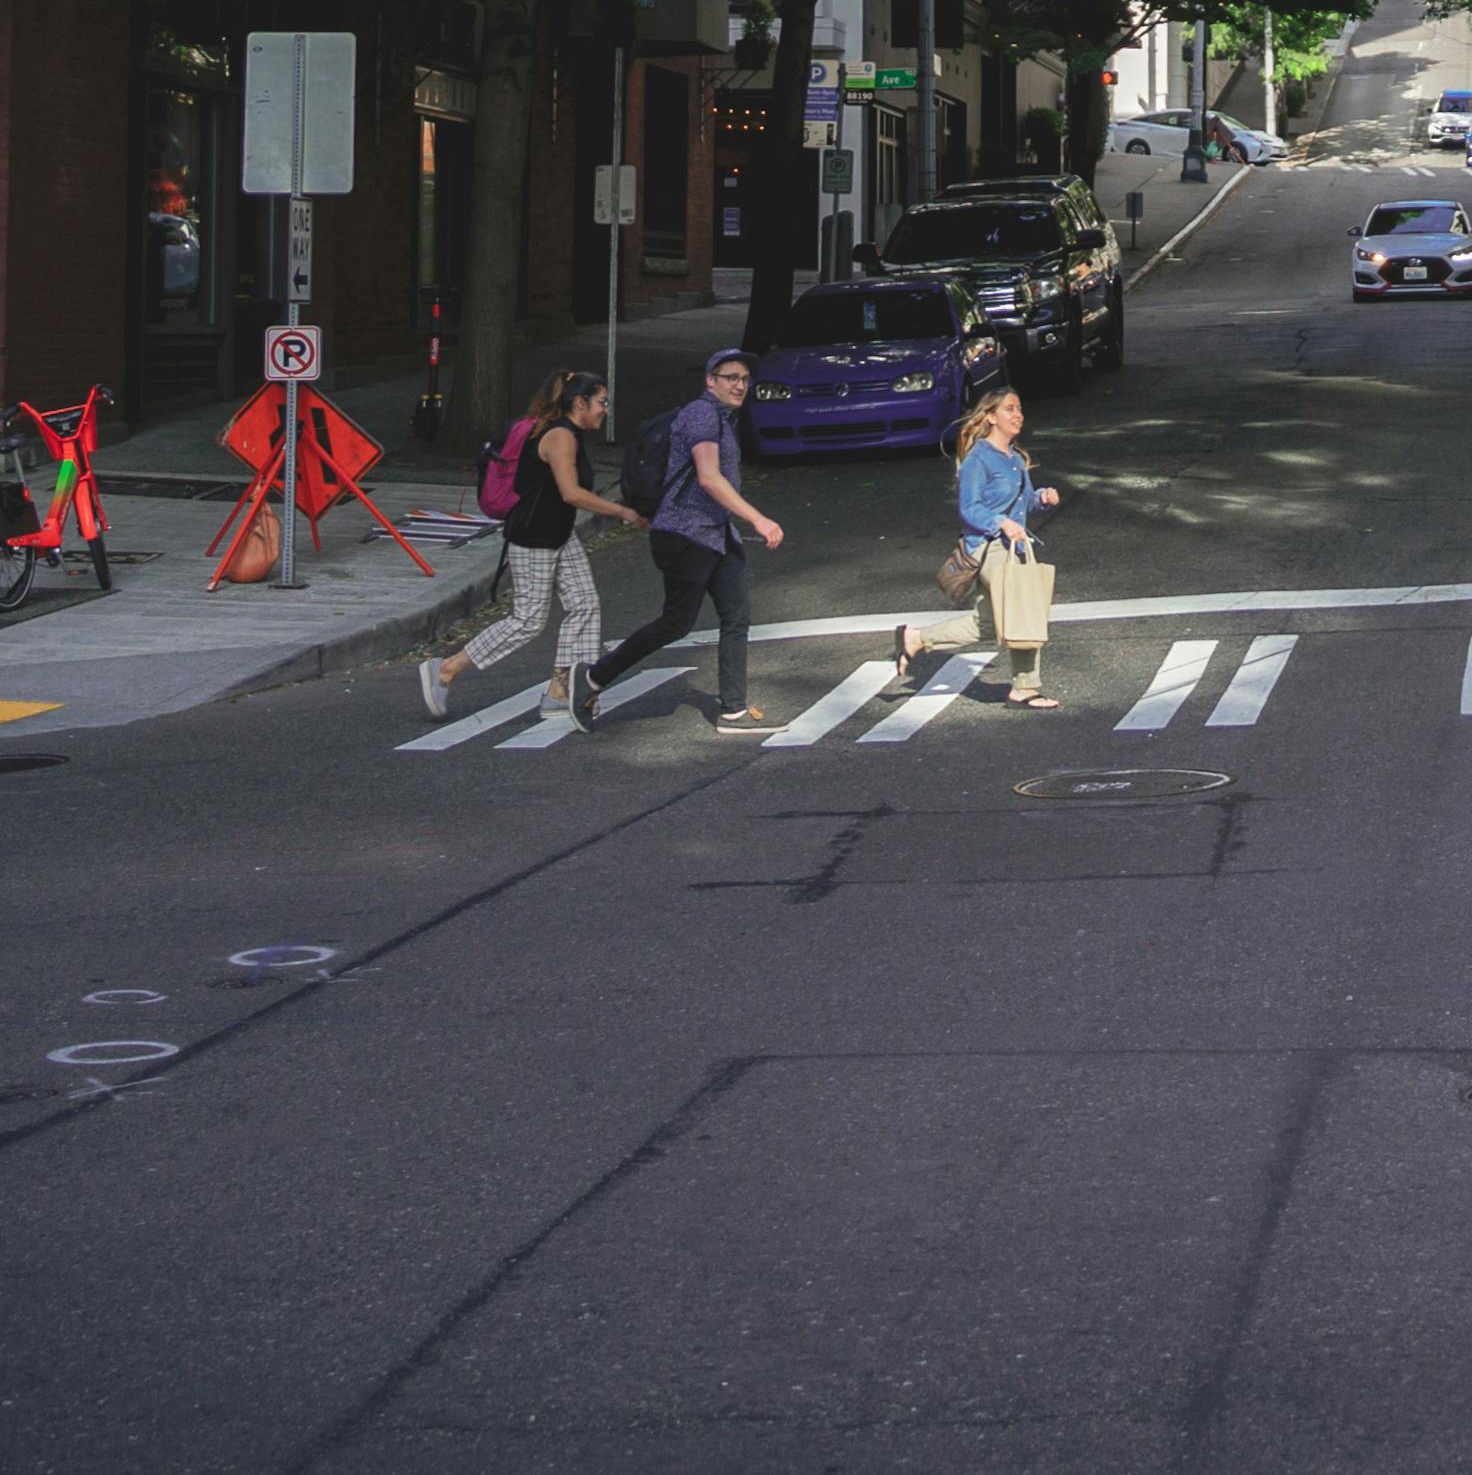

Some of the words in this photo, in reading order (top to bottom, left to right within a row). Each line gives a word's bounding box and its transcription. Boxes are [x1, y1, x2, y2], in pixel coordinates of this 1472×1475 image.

[882, 75, 900, 84] Ave
[293, 207, 310, 232] ONE
[293, 237, 309, 261] WAY
